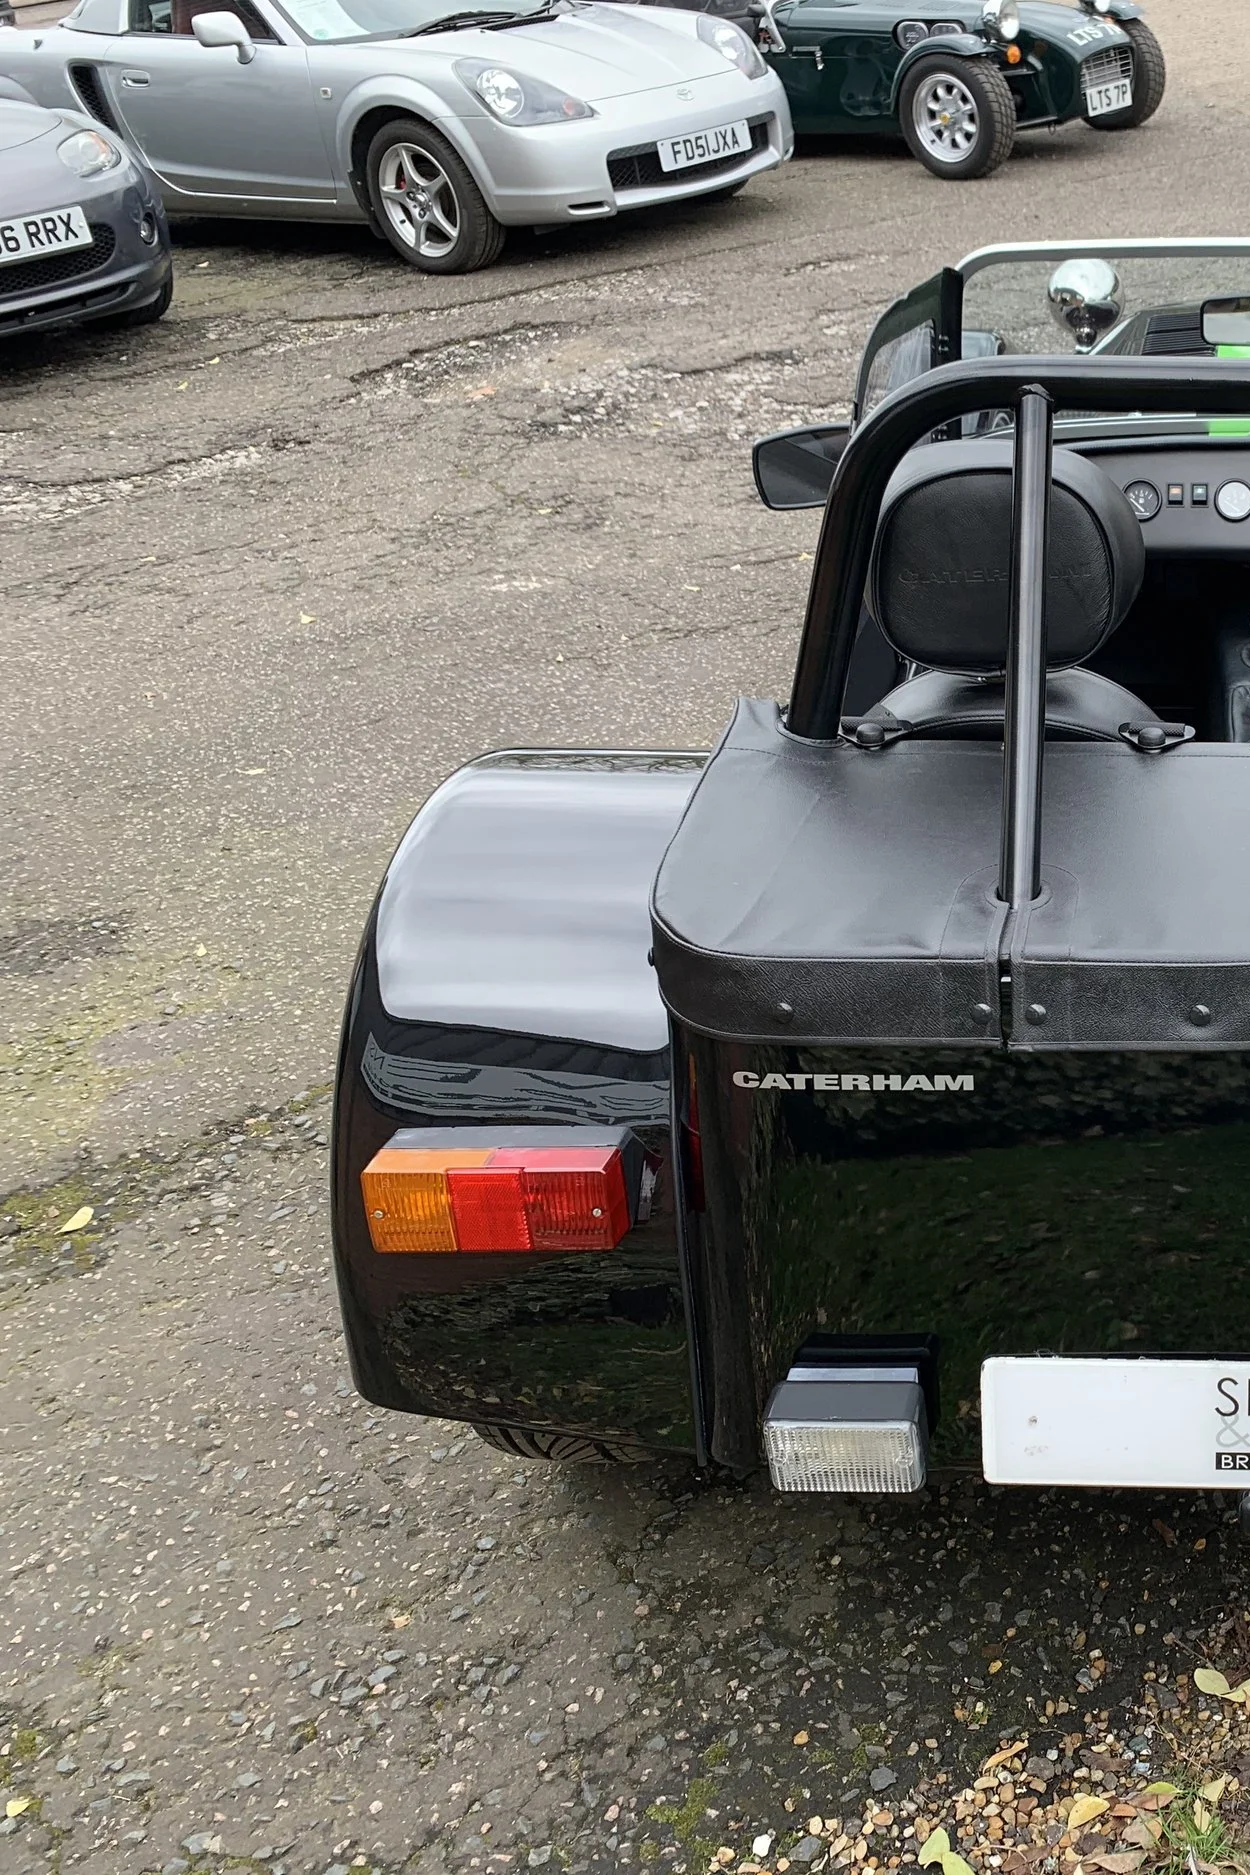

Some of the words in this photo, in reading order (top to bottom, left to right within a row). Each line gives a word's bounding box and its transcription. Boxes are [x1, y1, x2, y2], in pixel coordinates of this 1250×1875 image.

[1066, 26, 1104, 46] LTS
[1089, 87, 1112, 112] LTS
[1114, 84, 1128, 105] 7P
[670, 127, 741, 164] FD51JXA
[0, 225, 20, 255] 6
[23, 212, 79, 248] RRX
[732, 1070, 975, 1091] CATERHAM
